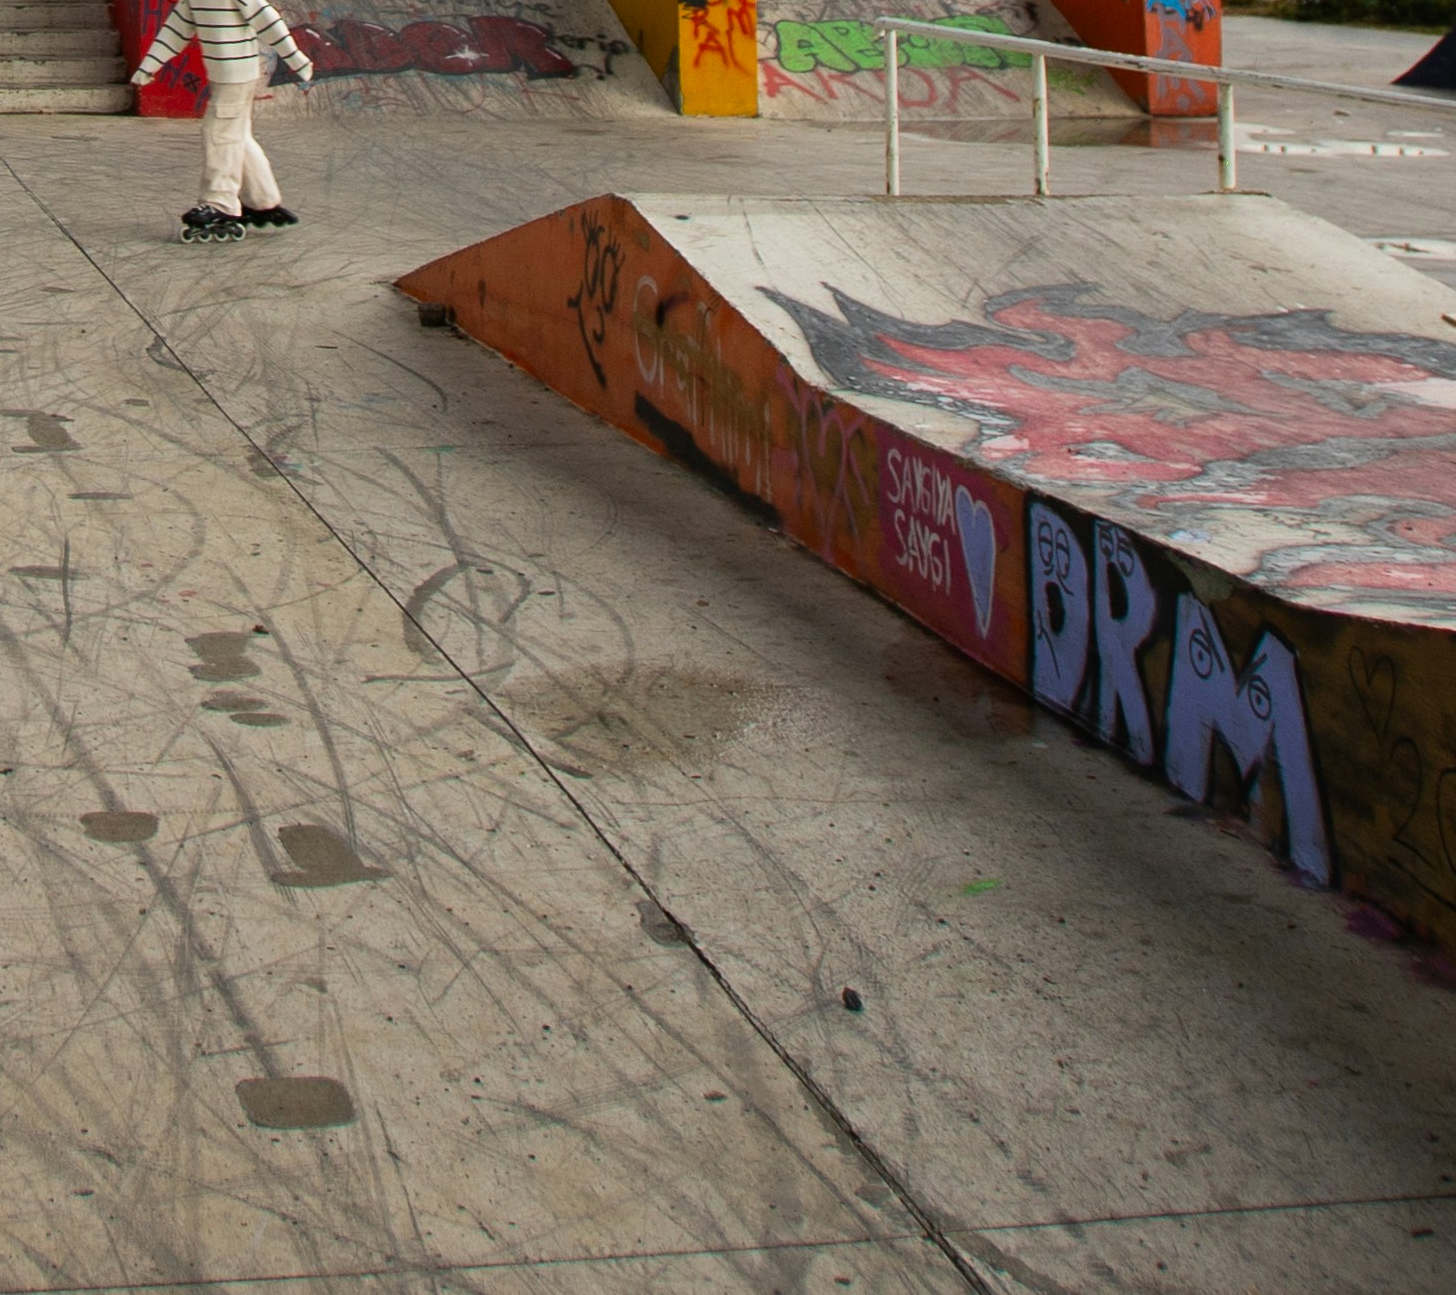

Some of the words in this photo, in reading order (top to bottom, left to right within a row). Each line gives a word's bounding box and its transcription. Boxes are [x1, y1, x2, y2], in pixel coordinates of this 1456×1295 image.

[886, 447, 957, 536] SAYGIYA
[894, 507, 952, 598] SAYGI
[1028, 498, 1334, 888] DRM
